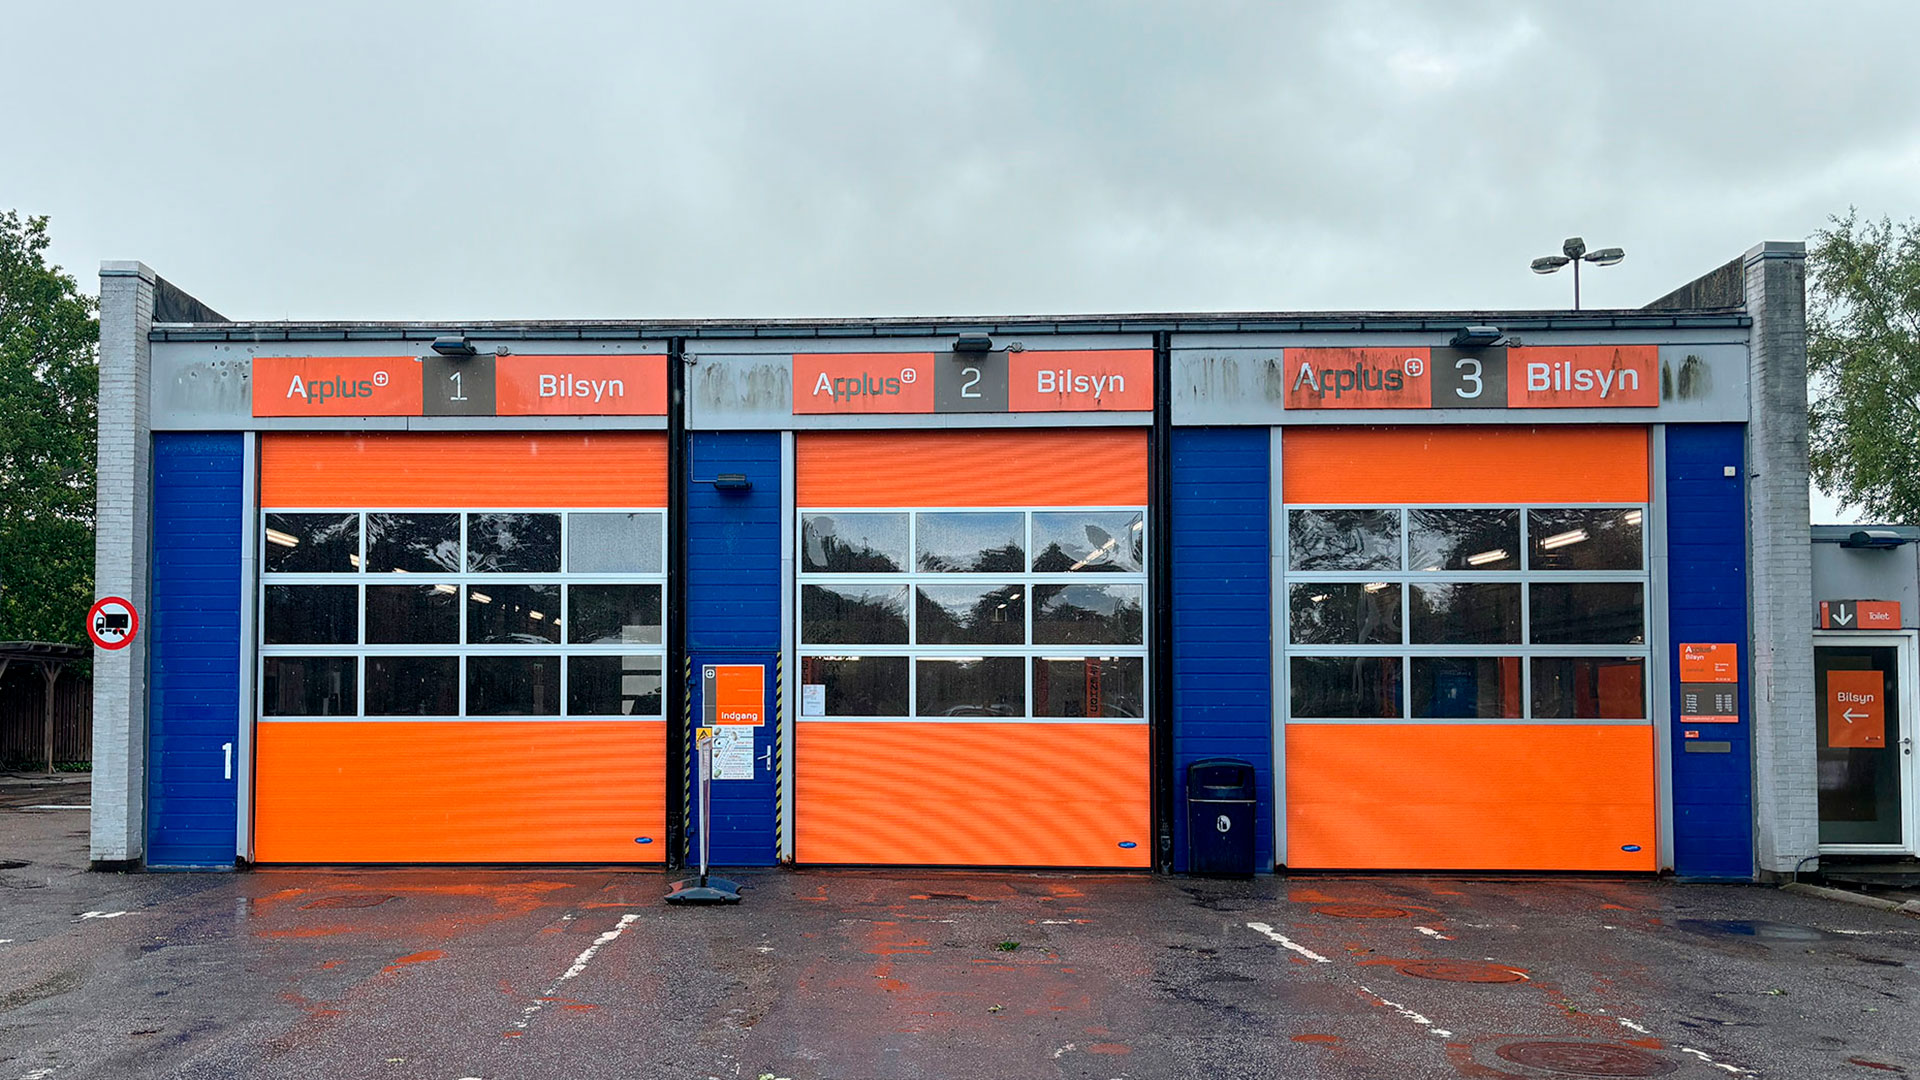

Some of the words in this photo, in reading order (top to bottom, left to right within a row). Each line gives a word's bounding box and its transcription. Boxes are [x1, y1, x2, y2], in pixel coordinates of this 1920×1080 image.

[448, 371, 468, 401] 1
[538, 373, 624, 403] Bilsyn
[960, 367, 982, 398] 2
[1037, 369, 1125, 399] Bilsyn
[1454, 358, 1484, 399] 3
[1526, 361, 1639, 399] Bilsyn
[1868, 612, 1890, 621] Toilet
[1837, 692, 1875, 704] Bilsyn
[721, 711, 758, 722] Indgang
[222, 742, 232, 780] 1
